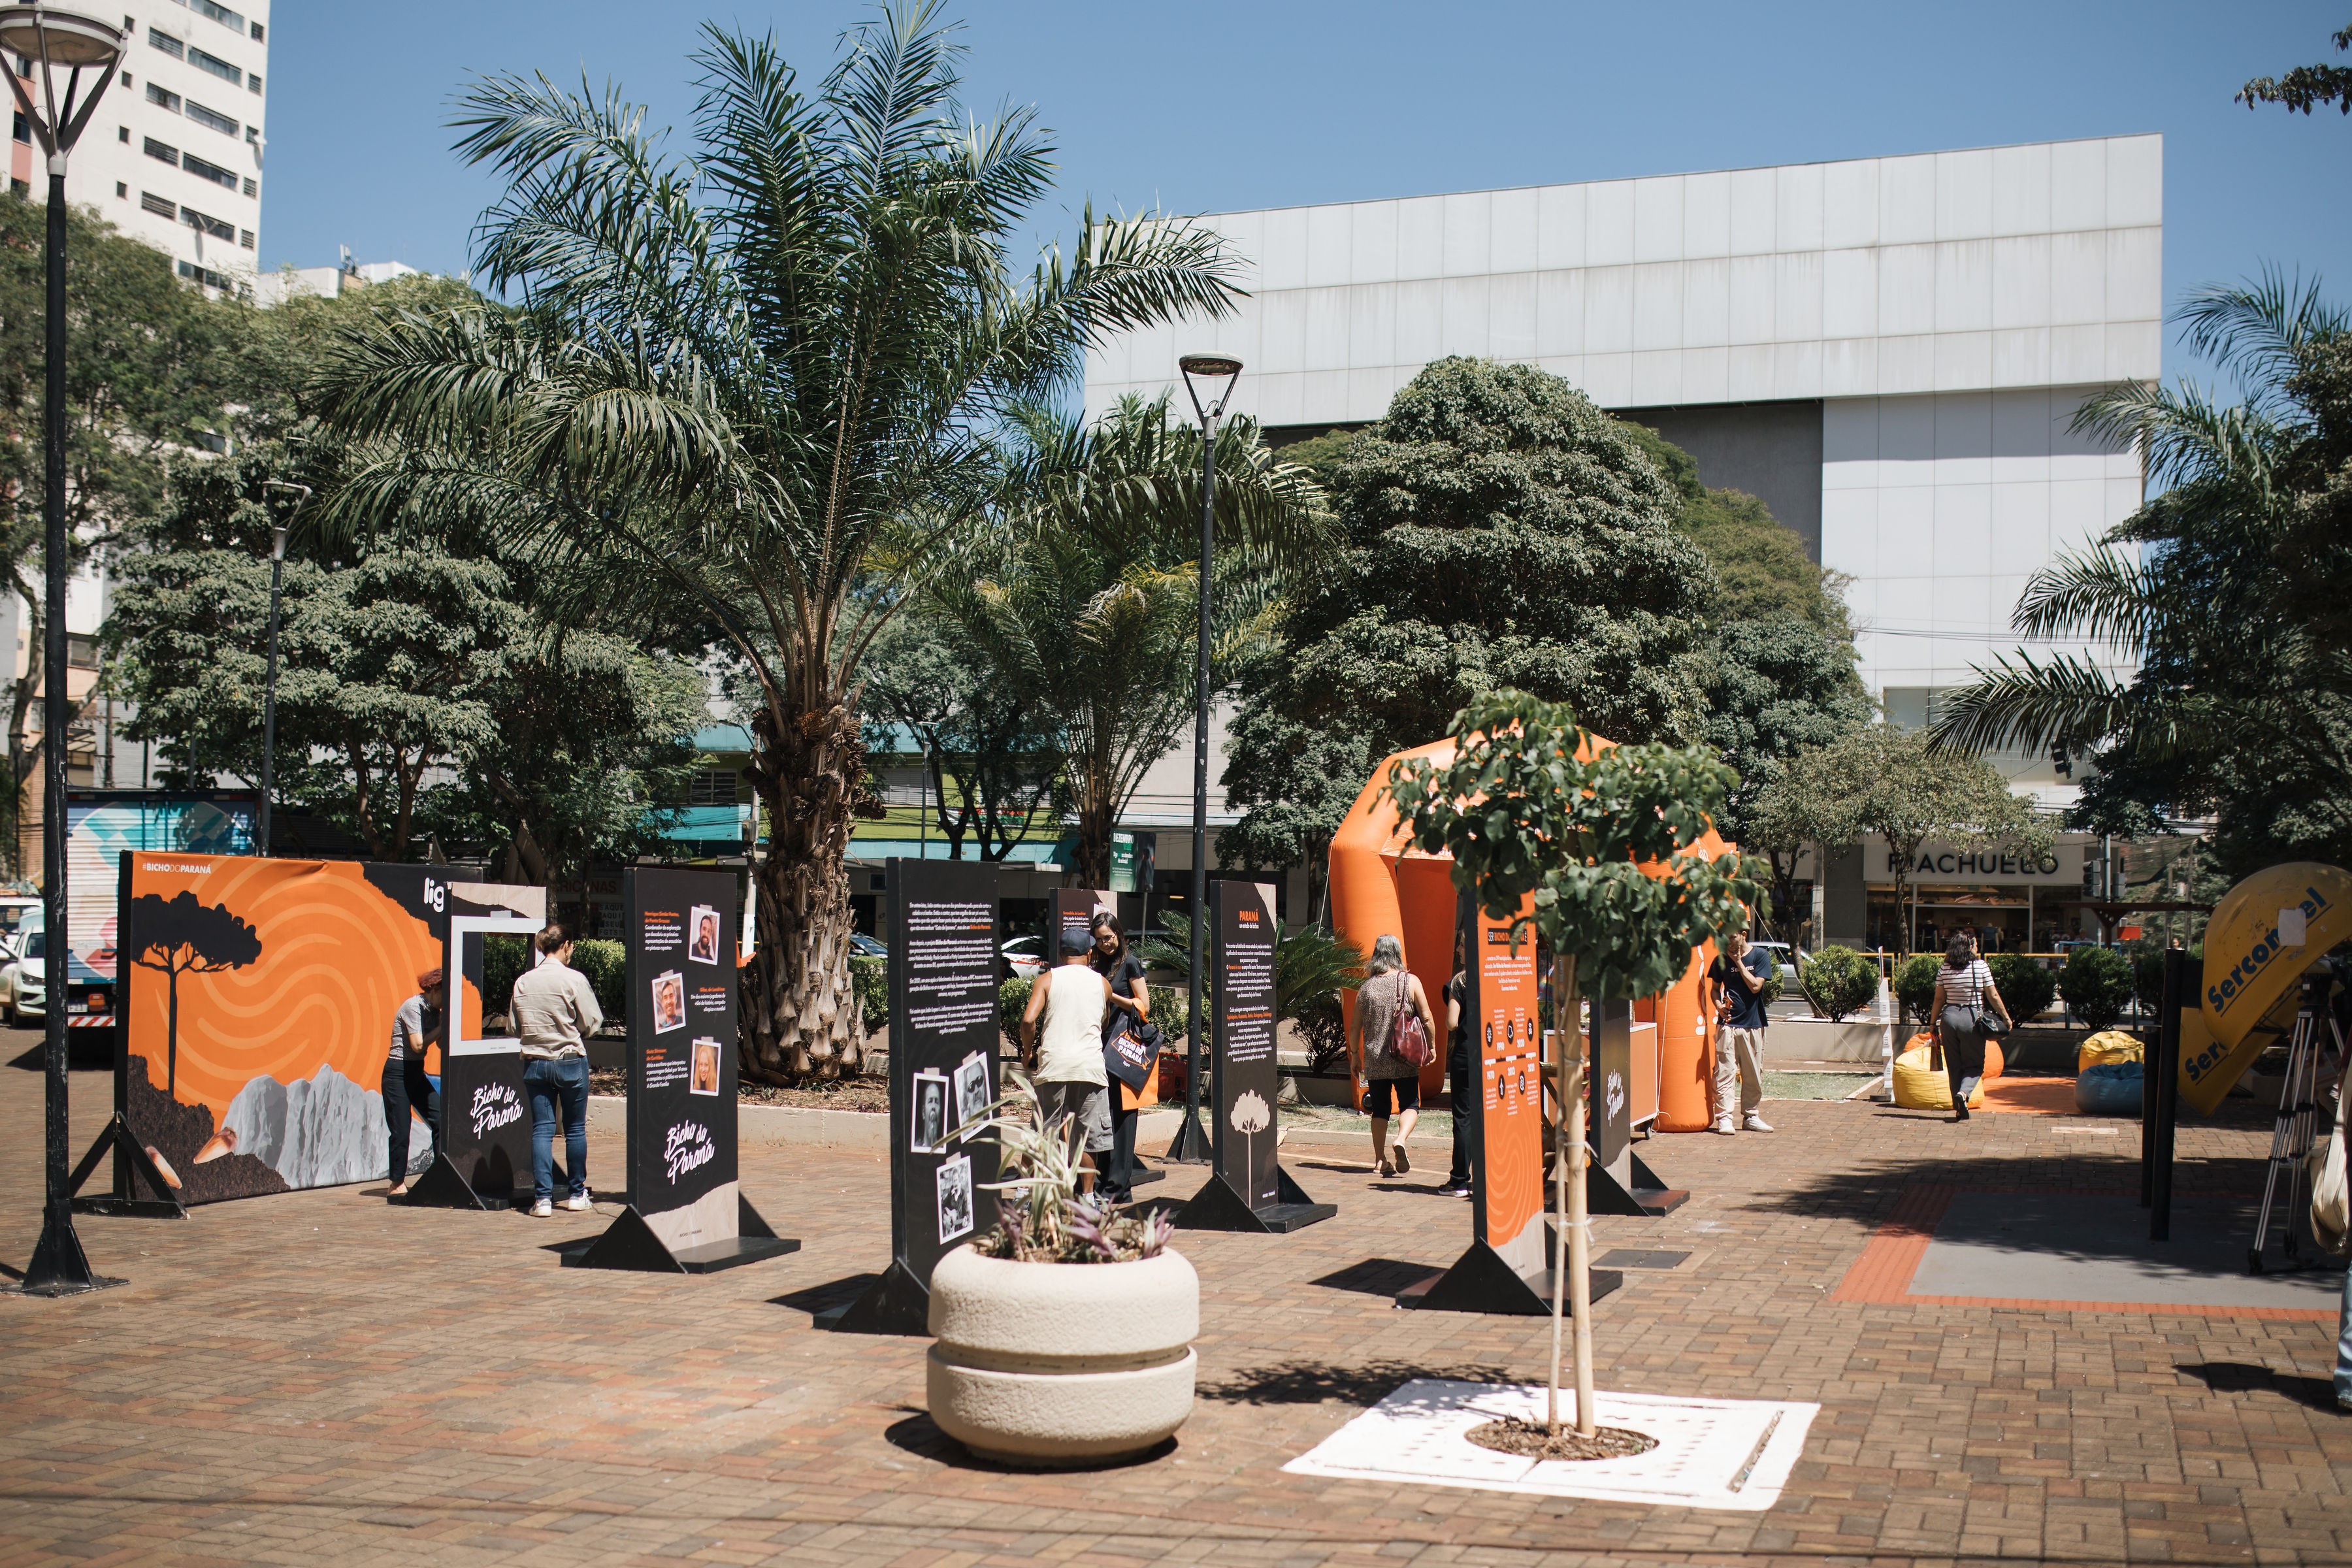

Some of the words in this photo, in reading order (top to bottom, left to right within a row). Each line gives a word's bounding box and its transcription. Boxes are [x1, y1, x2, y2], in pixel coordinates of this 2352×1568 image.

[142, 862, 211, 874] #BICHODOPARANÁ
[1239, 908, 1259, 922] PARANÁ
[1118, 1037, 1136, 1052] BICHO
[470, 1082, 504, 1119] Bicho
[504, 1086, 515, 1104] do
[473, 1098, 523, 1140] Paraná
[664, 1120, 696, 1162] Bicho
[696, 1124, 708, 1143] do
[667, 1137, 715, 1185] Paraná
